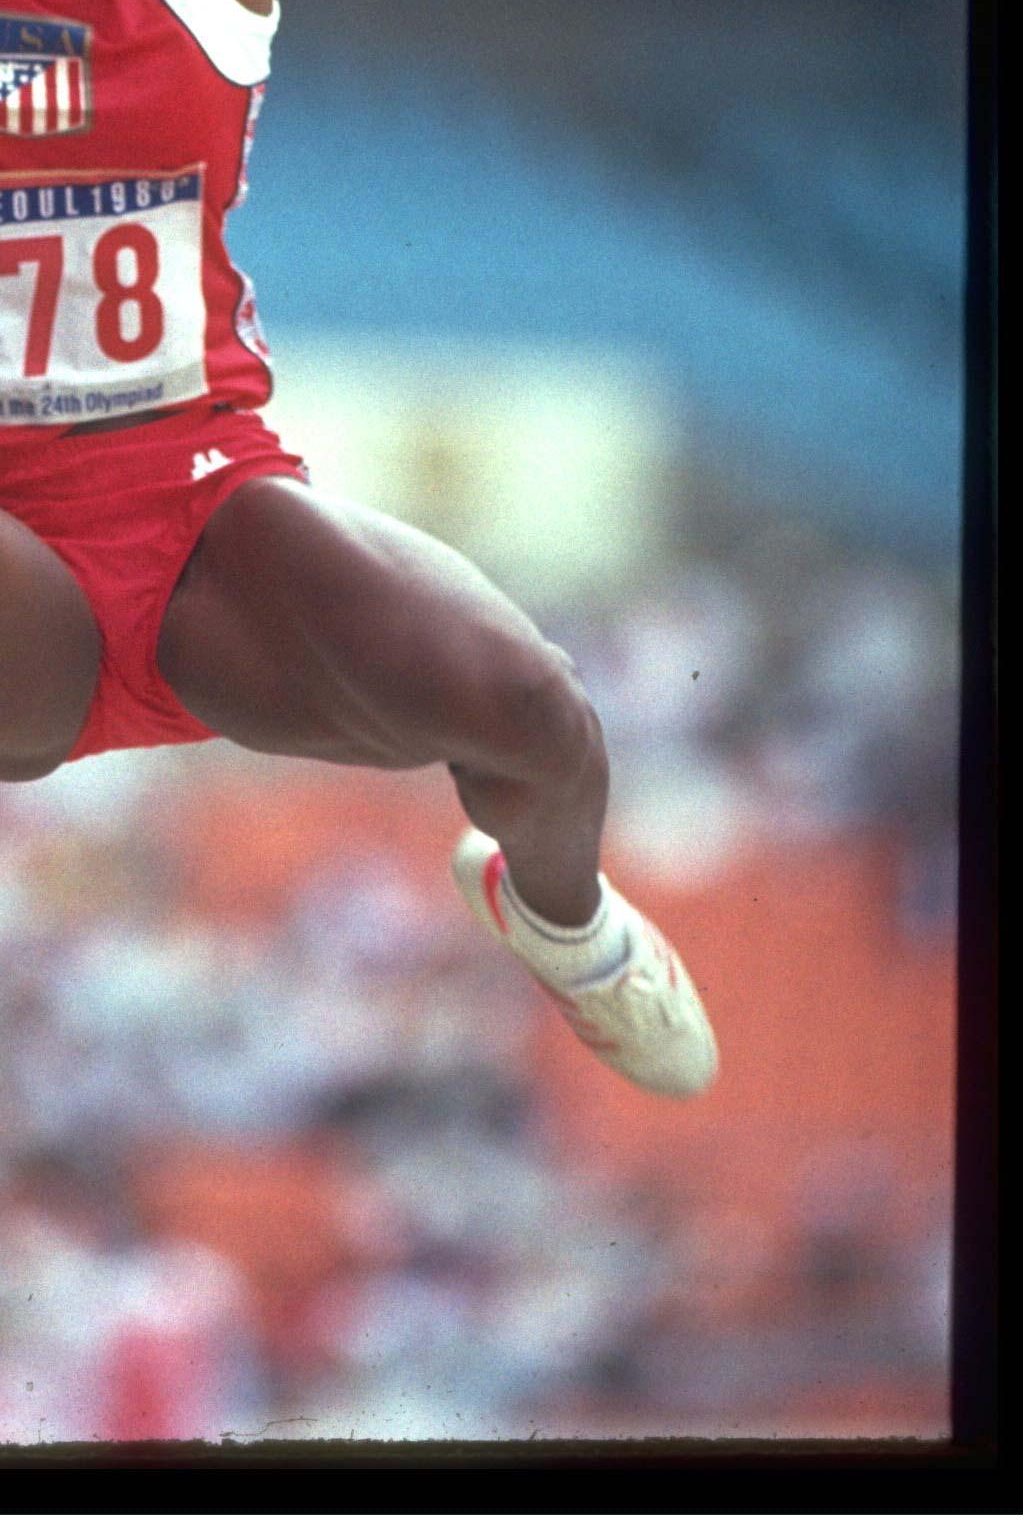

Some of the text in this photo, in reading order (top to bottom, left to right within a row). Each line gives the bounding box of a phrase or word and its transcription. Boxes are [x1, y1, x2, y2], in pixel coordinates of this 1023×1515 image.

[8, 398, 36, 417] the
[42, 392, 82, 416] 24th
[86, 382, 164, 414] Olympiad
